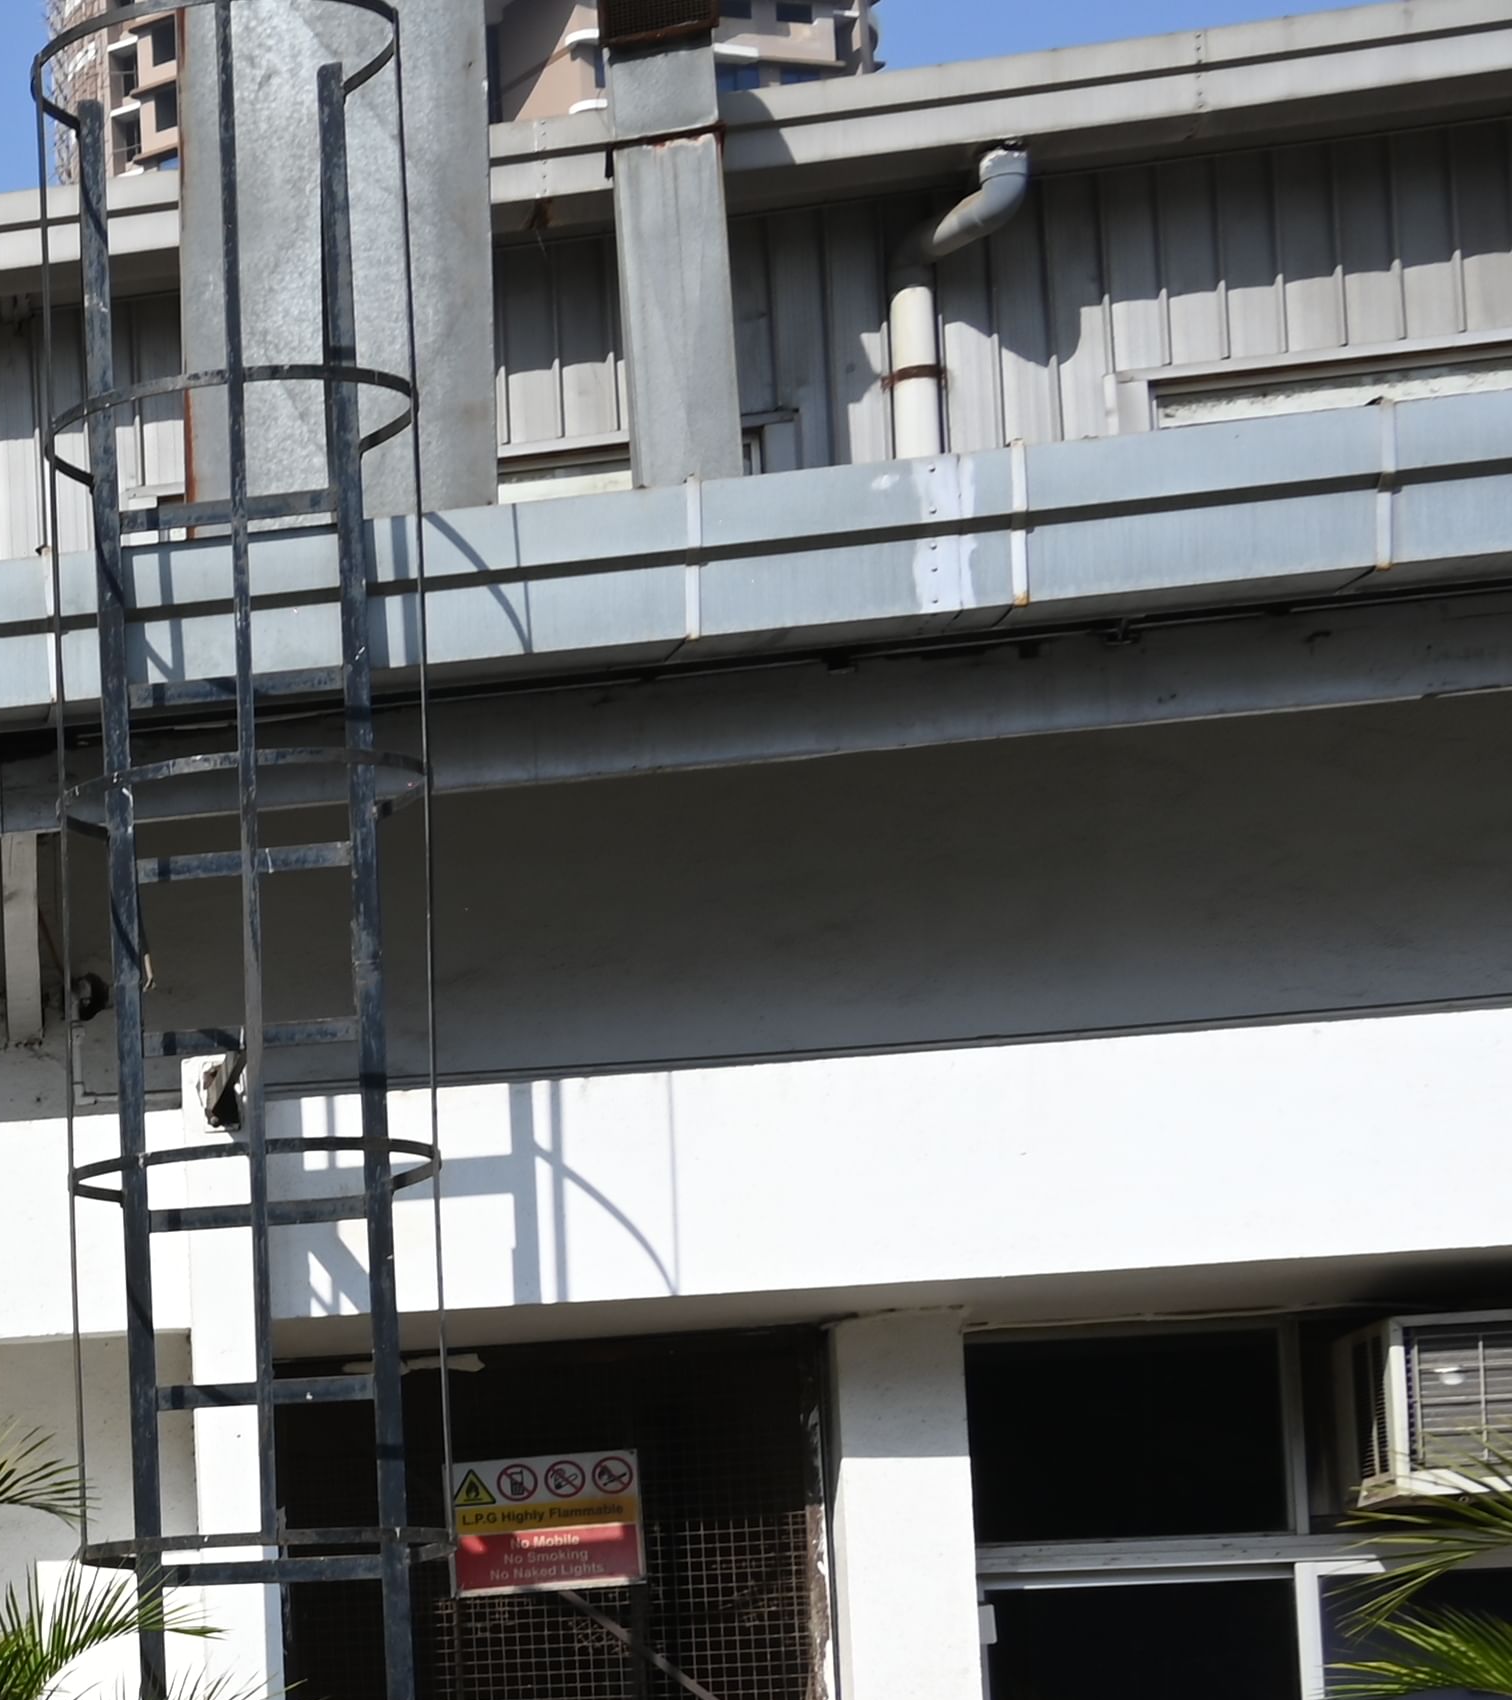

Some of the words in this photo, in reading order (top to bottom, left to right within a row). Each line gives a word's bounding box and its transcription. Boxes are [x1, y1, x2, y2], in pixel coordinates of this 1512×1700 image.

[501, 1507, 545, 1525] Highly
[549, 1502, 624, 1520] Flammable
[509, 1535, 530, 1550] No
[533, 1533, 580, 1549] Mobile
[503, 1553, 524, 1566] No
[527, 1549, 589, 1565] Smoking
[490, 1568, 510, 1581] No
[514, 1564, 557, 1579] Naked
